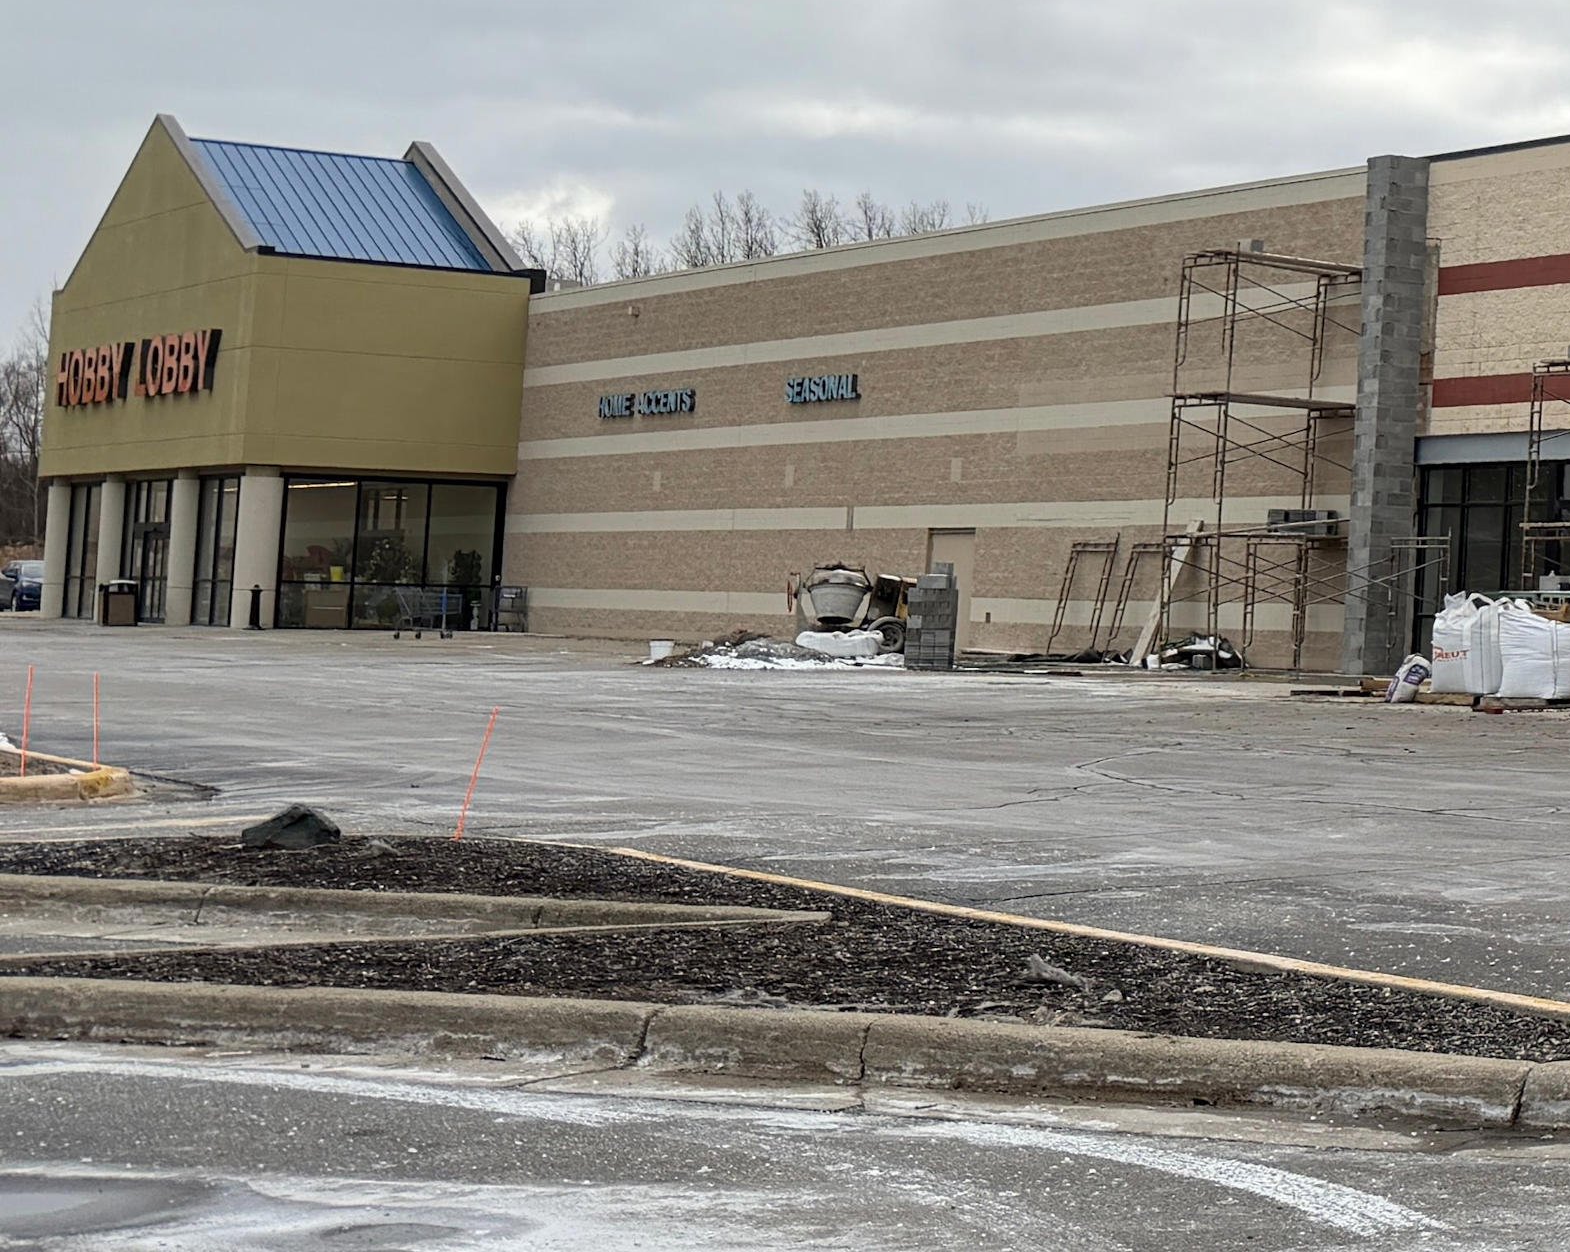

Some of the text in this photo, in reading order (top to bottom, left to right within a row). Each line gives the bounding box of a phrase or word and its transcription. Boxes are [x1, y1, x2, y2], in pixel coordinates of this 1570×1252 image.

[56, 330, 215, 408] HOBBY LOBBY
[784, 374, 859, 402] SEASONAL
[599, 389, 694, 417] HOME ACCENTS
